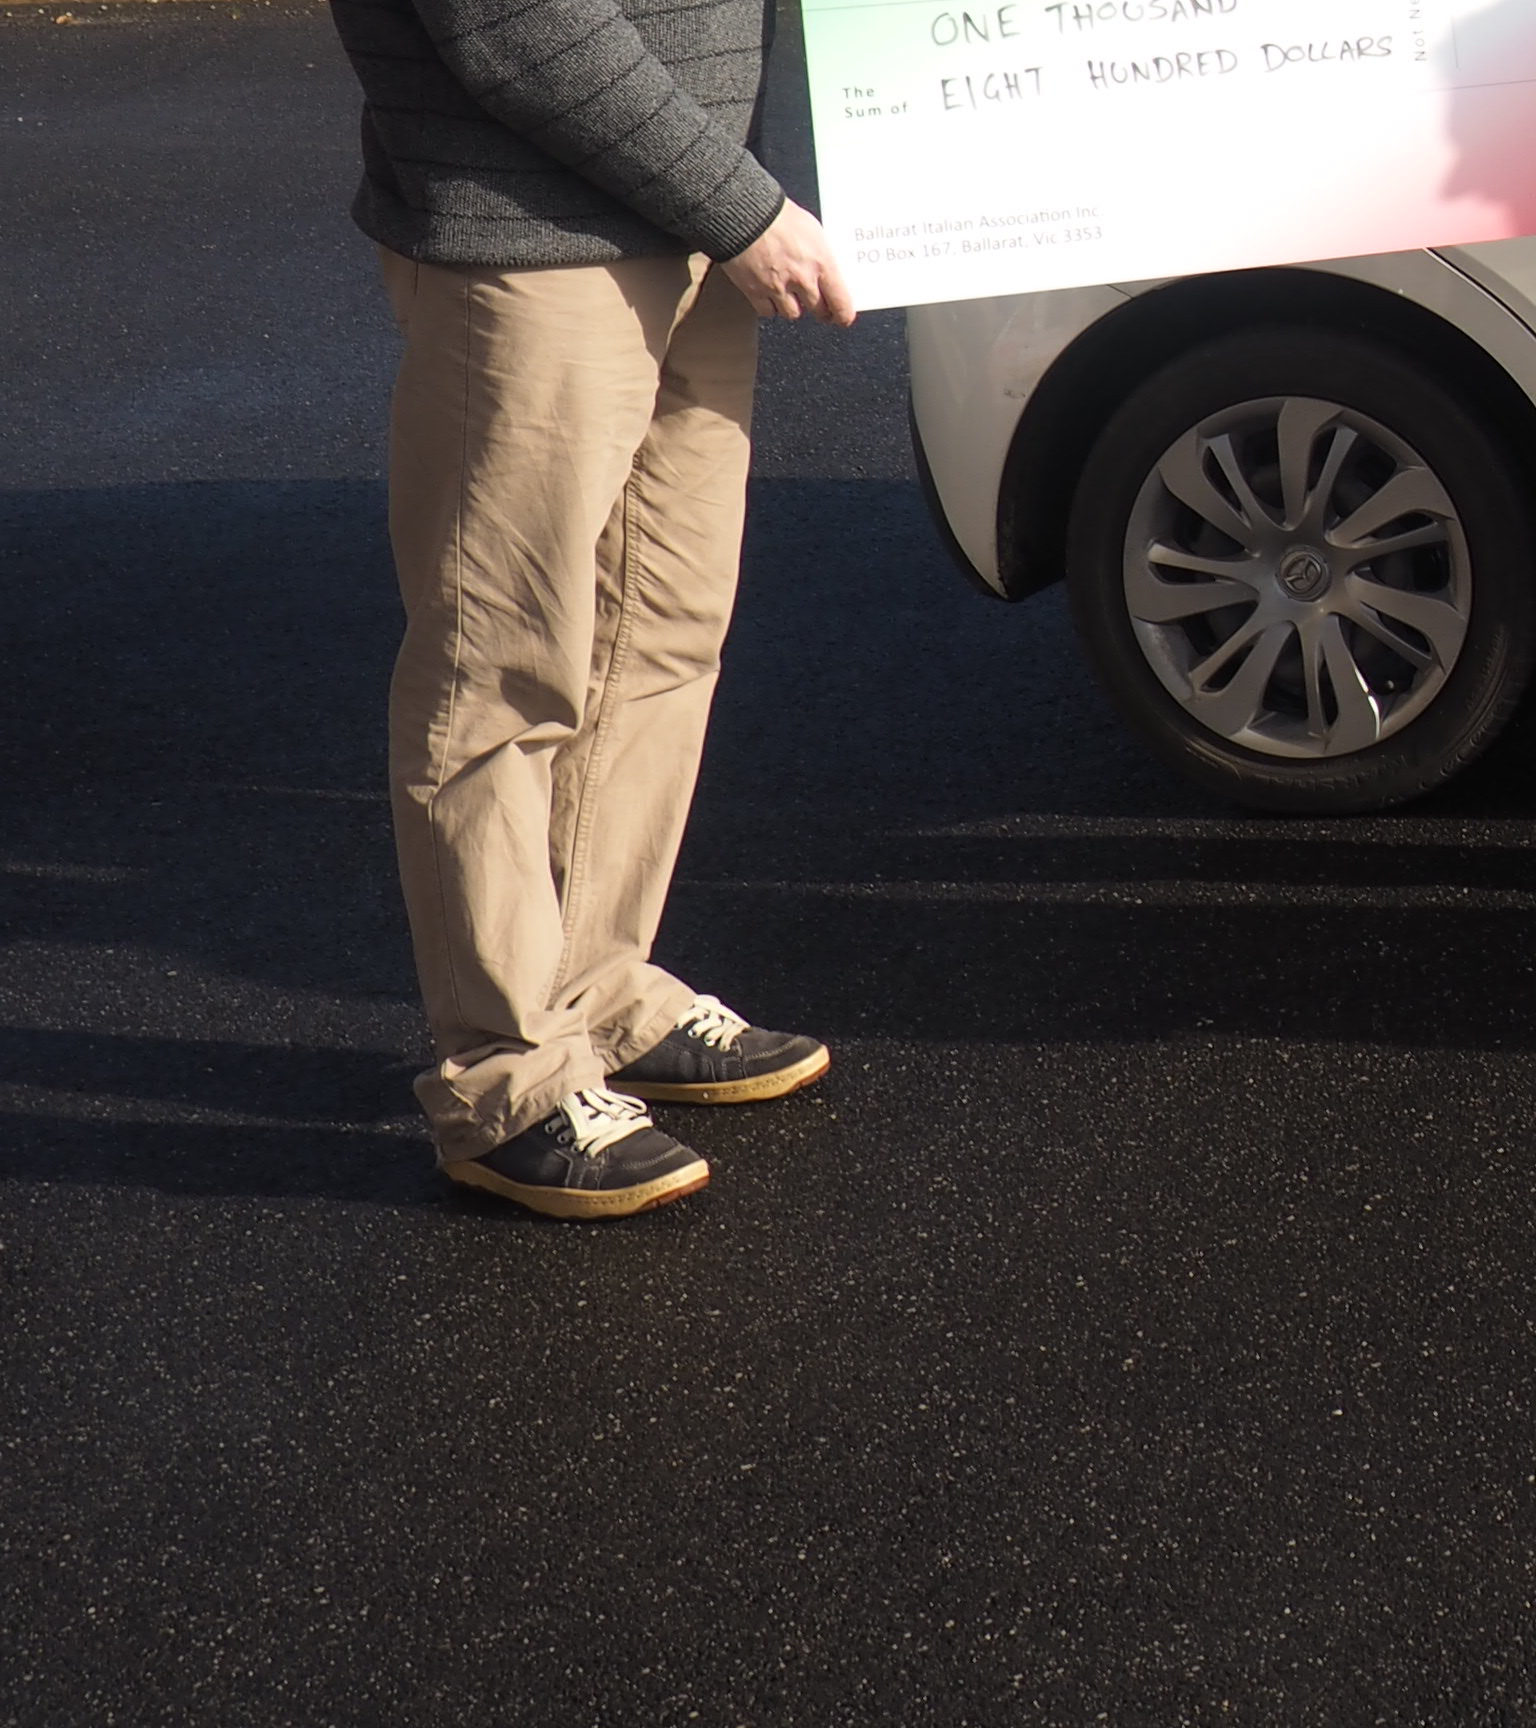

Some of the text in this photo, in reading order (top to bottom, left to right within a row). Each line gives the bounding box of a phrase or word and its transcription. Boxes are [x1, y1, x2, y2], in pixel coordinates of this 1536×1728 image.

[930, 4, 1020, 47] ONE
[1414, 30, 1426, 62] Not
[940, 35, 1394, 112] EIGHT HUNDRED DOLLARS
[842, 87, 875, 100] The
[844, 101, 909, 119] Sum of
[854, 224, 918, 242] Ballarat
[922, 218, 975, 235] Italian
[978, 208, 1072, 229] Association
[856, 250, 881, 265] PO
[886, 247, 917, 261] Box
[1063, 226, 1104, 244] 3353
